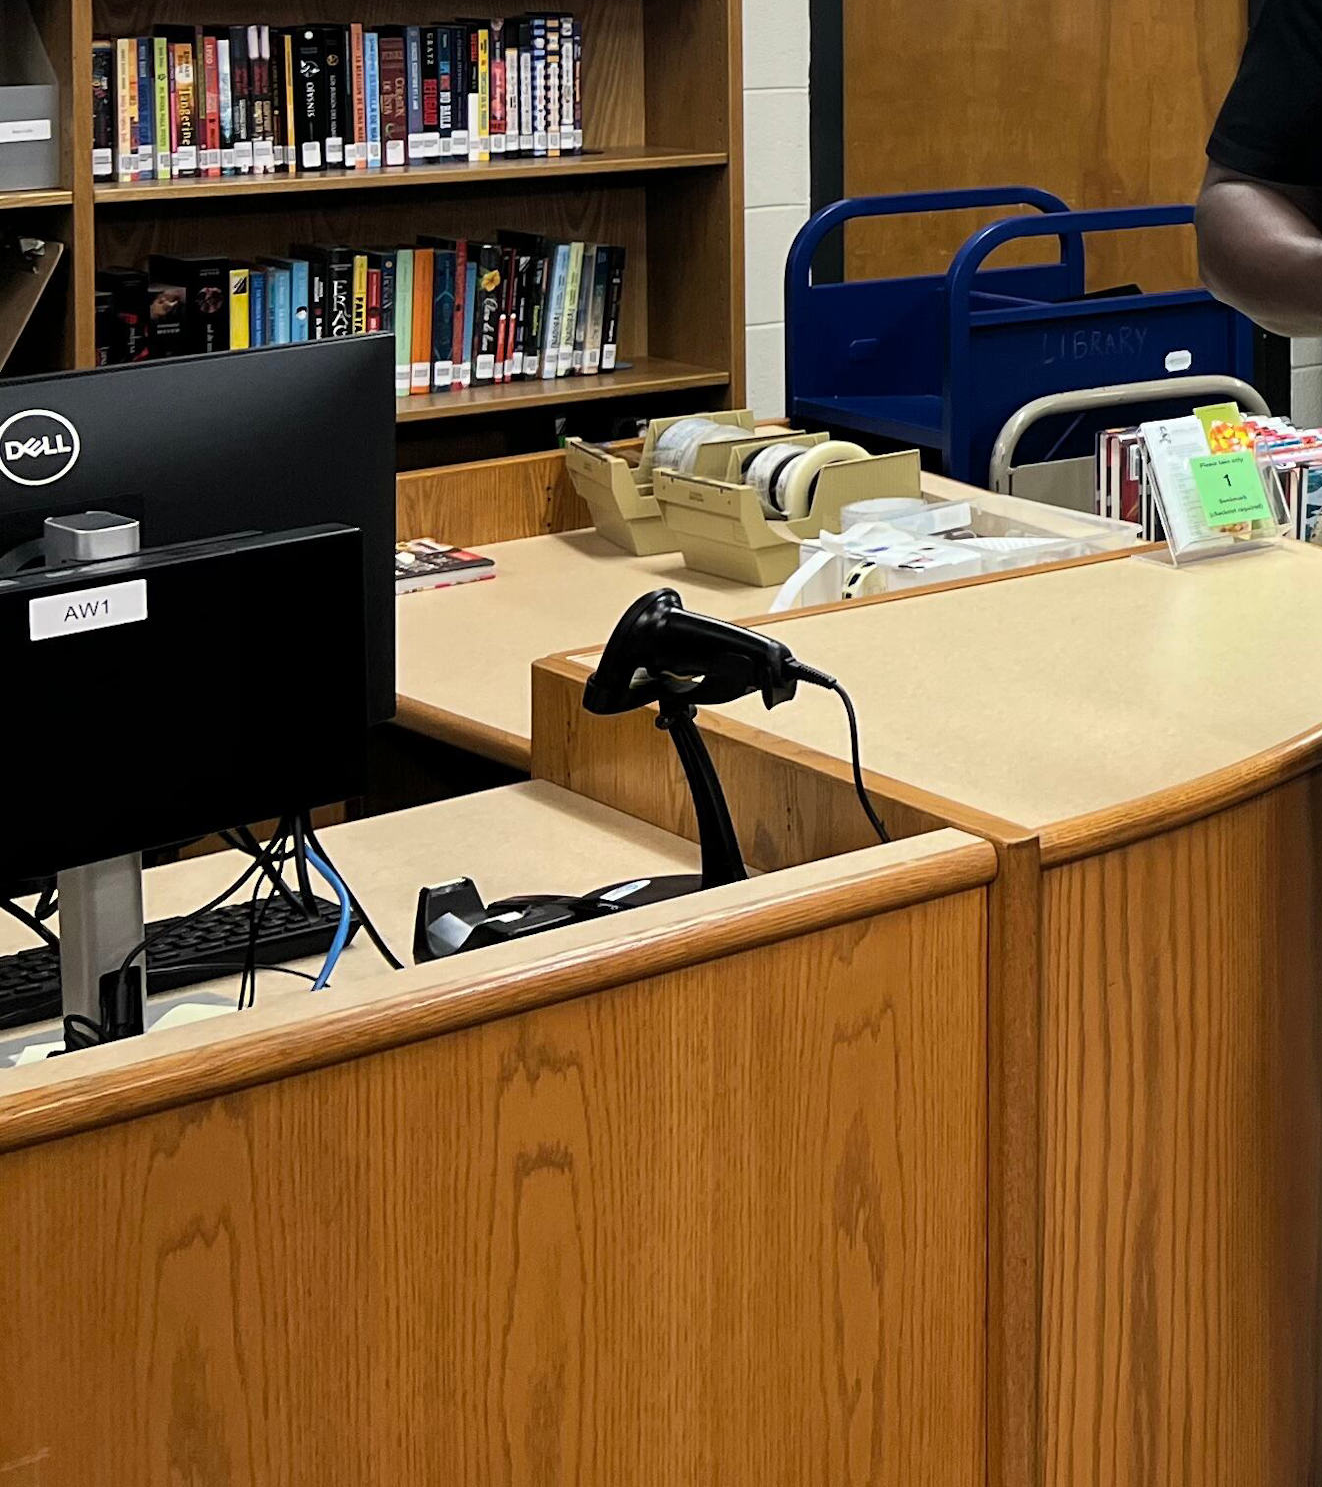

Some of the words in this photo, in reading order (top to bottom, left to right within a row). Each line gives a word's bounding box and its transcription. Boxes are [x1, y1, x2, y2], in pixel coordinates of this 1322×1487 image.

[178, 86, 192, 145] Tangerine
[1042, 325, 1148, 364] LIBRARY
[4, 434, 71, 461] DELL
[1223, 474, 1232, 487] 1
[64, 599, 109, 622] AW1
